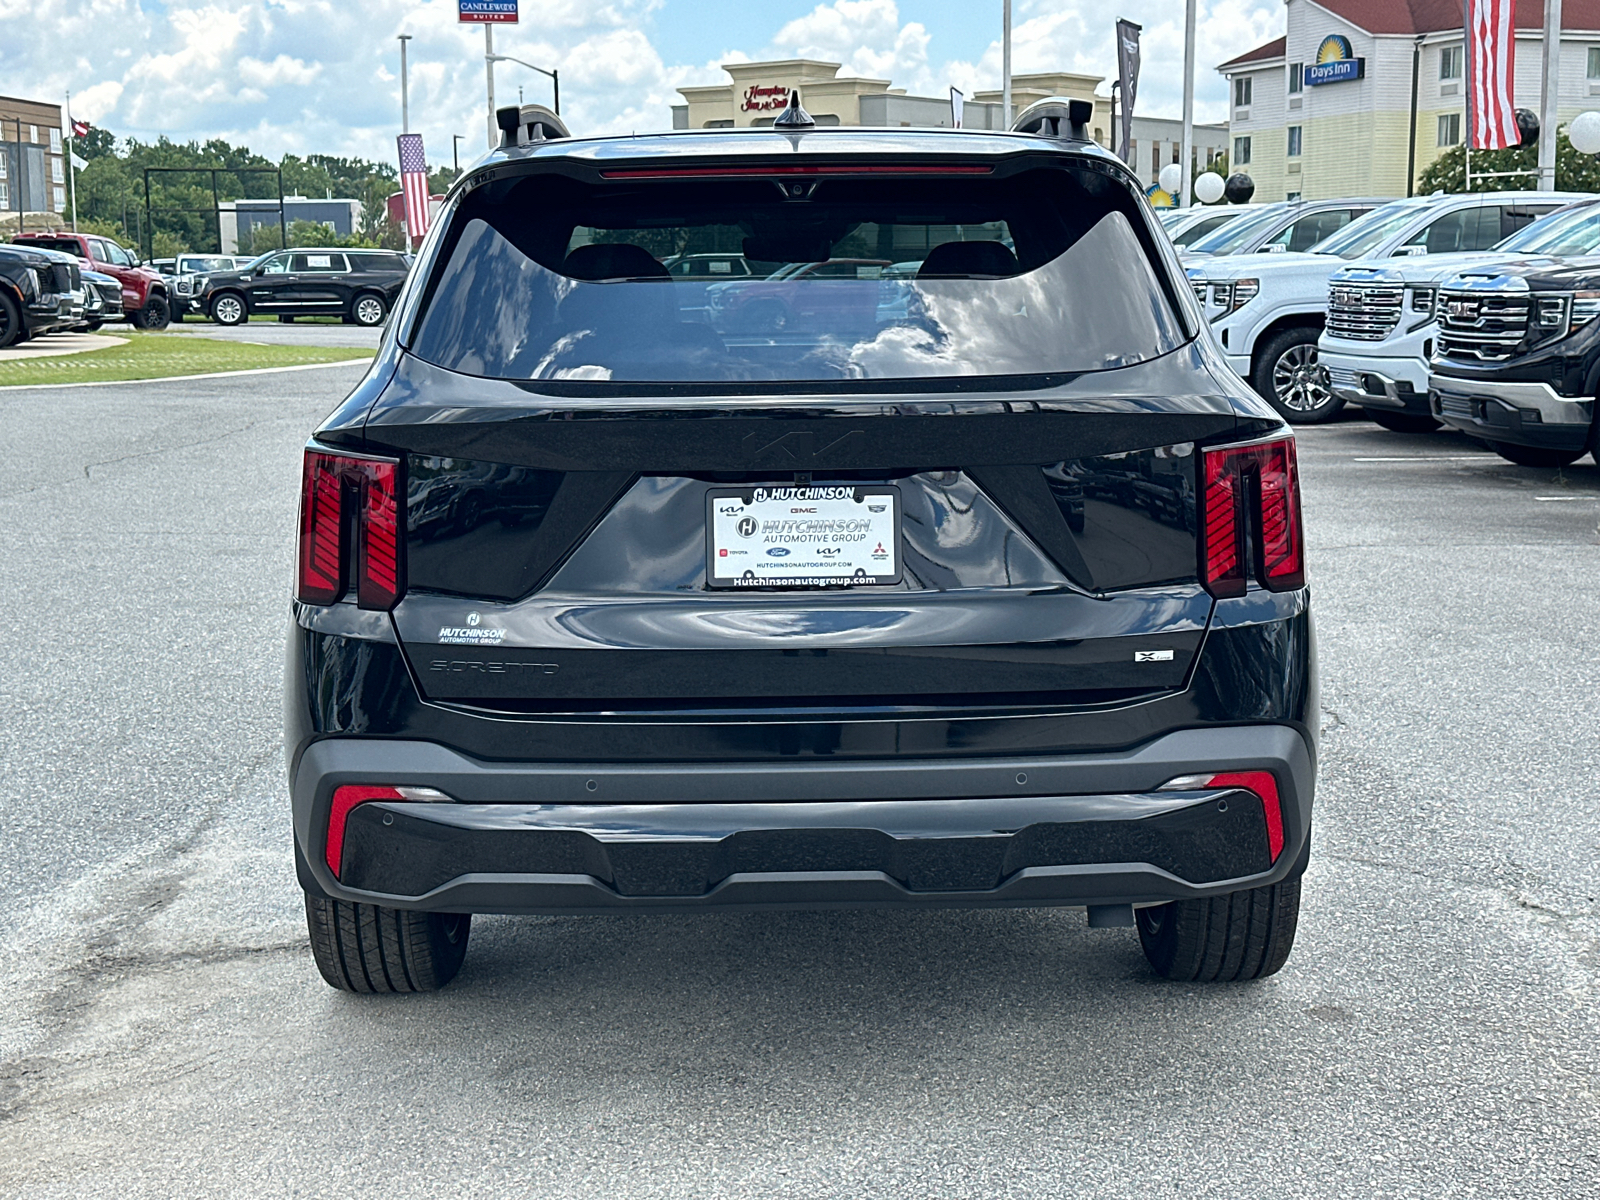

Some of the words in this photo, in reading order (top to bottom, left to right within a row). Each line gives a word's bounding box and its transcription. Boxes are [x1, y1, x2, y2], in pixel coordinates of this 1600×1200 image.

[1311, 66, 1333, 78] Days
[1334, 63, 1351, 75] Inn
[744, 84, 790, 100] Hampton
[770, 486, 855, 501] HUTCHINSON
[761, 519, 871, 533] HUTCHINSON
[763, 534, 829, 543] AUTOMOTIVE
[831, 534, 866, 542] GROUP
[770, 548, 787, 557] Ford
[733, 576, 877, 586] Hutchinsonautogroup.com
[439, 628, 506, 638] HUTCHINSON
[429, 660, 560, 675] SORENTO
